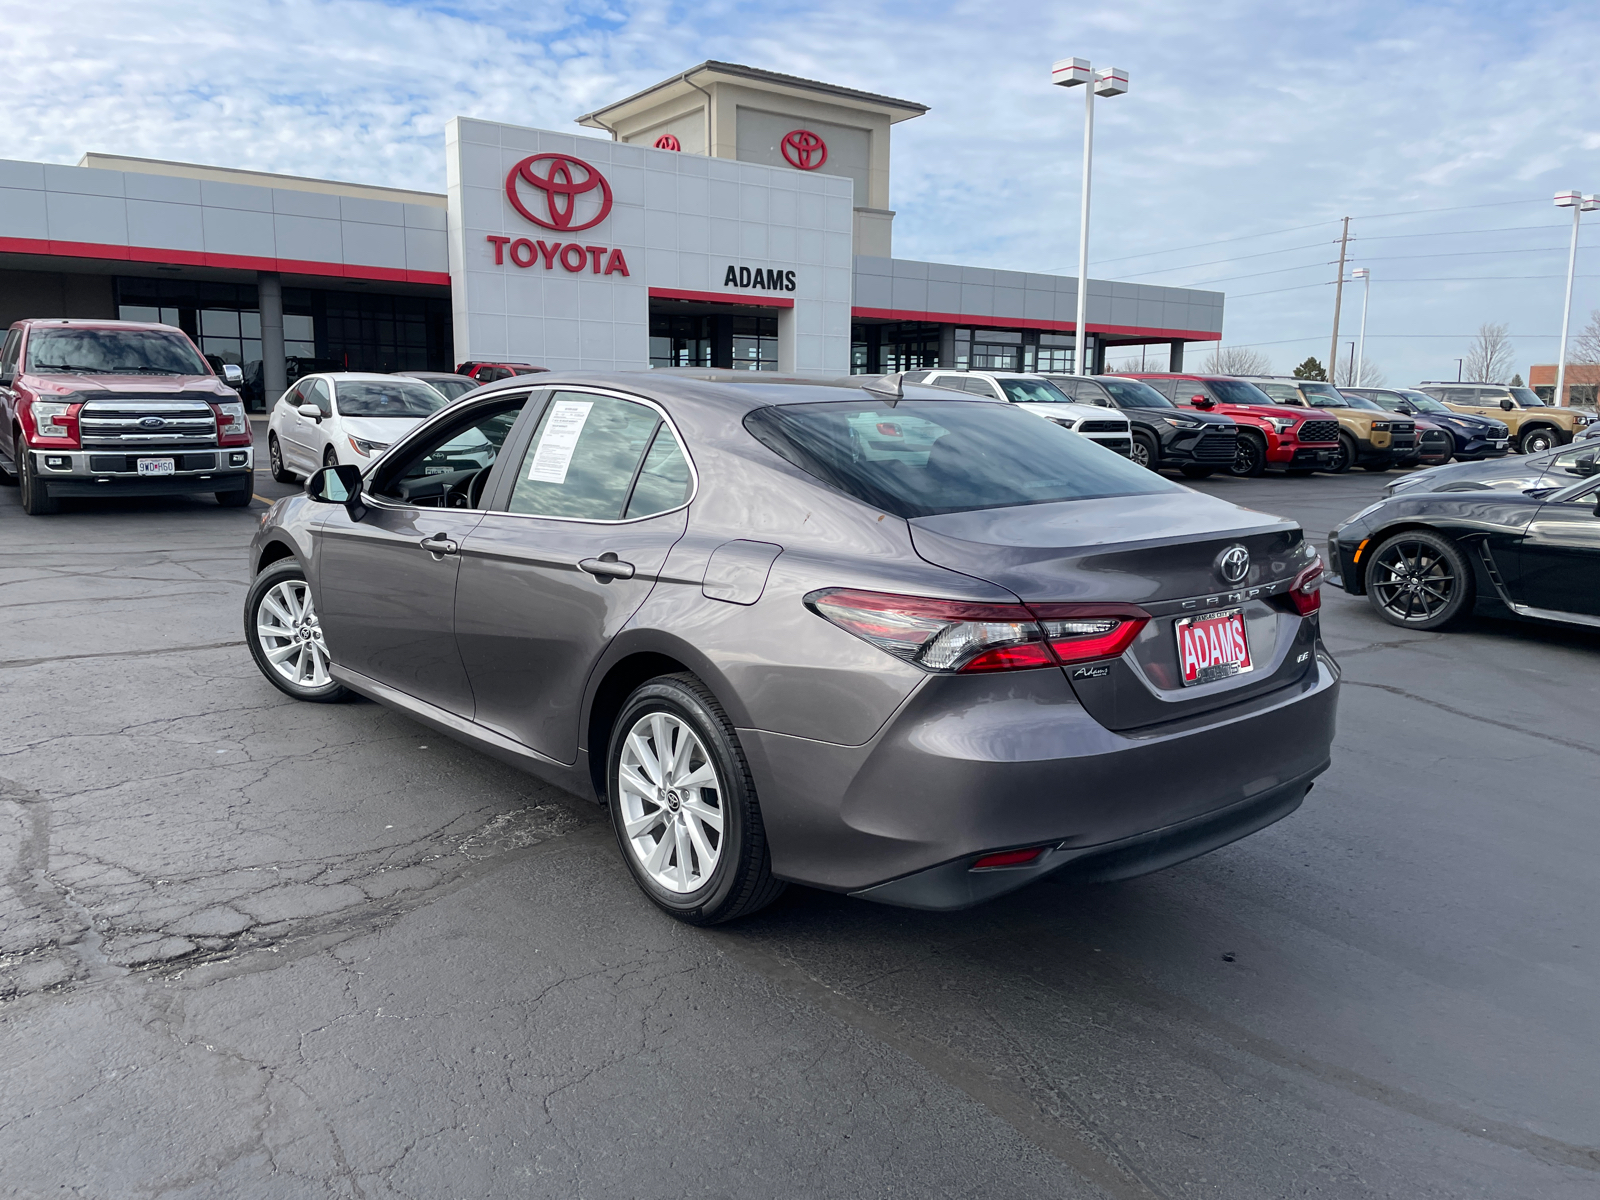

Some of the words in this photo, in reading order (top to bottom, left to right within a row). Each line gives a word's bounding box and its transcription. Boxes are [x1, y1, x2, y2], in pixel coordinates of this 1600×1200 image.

[487, 235, 630, 277] TOYOTA
[724, 265, 797, 292] ADAMS
[1184, 619, 1246, 674] ADAMS
[1074, 667, 1108, 677] Adams
